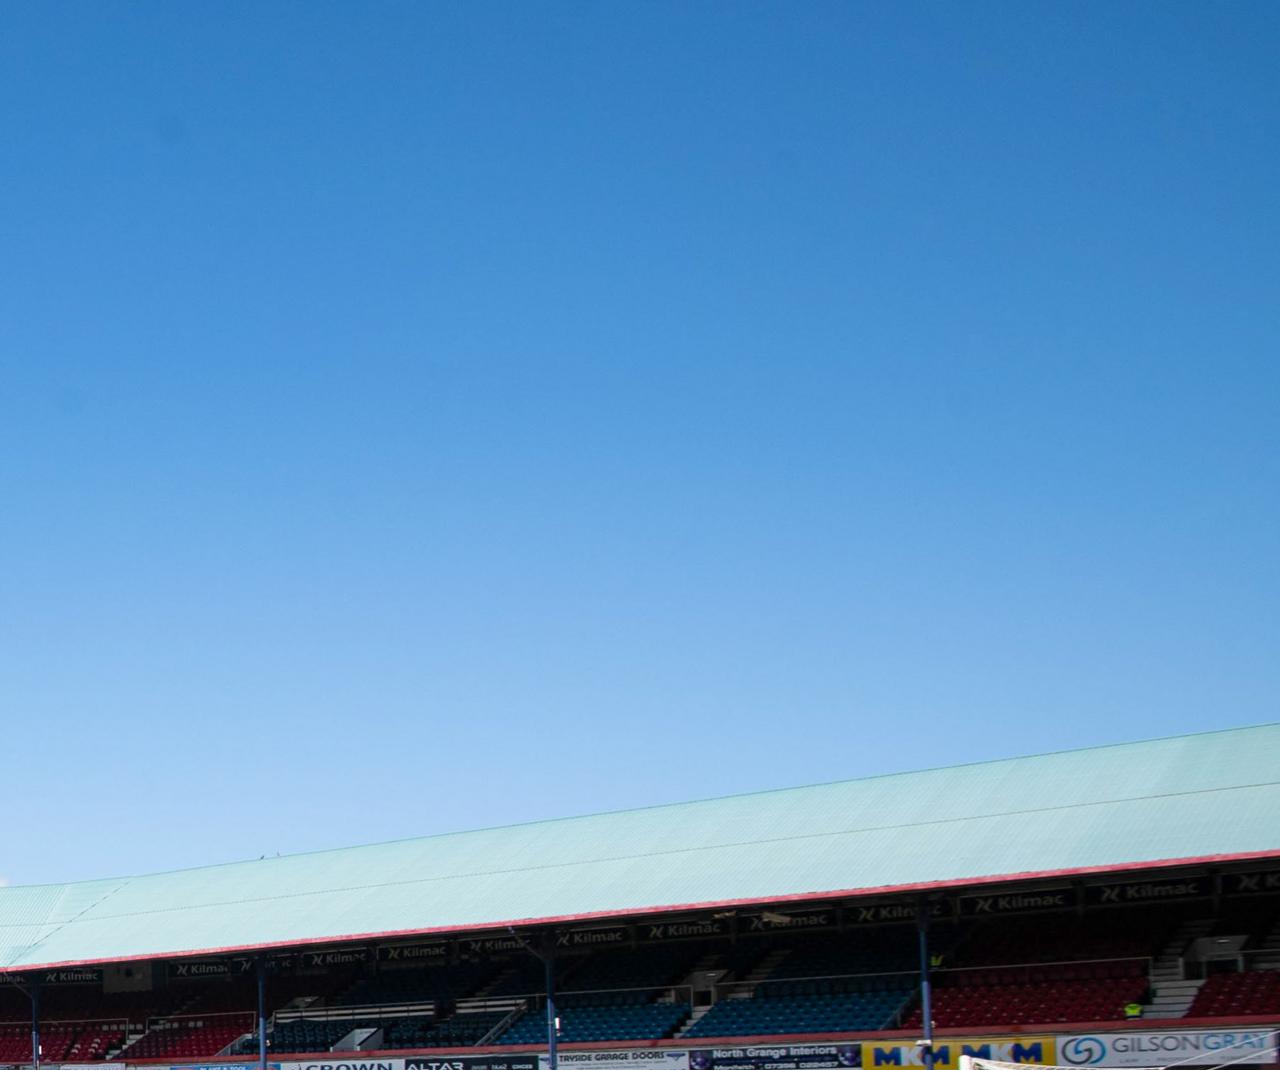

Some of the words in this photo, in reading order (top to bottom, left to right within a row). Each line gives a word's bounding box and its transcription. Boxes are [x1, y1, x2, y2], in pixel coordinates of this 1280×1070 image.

[558, 1055, 592, 1063] TAYSIDE
[595, 1053, 630, 1062] GARAGE
[632, 1051, 665, 1060] DOORS
[713, 1048, 743, 1059] North
[746, 1047, 786, 1060] Grange
[790, 1046, 837, 1057] Interiors
[873, 1045, 950, 1067] MKM
